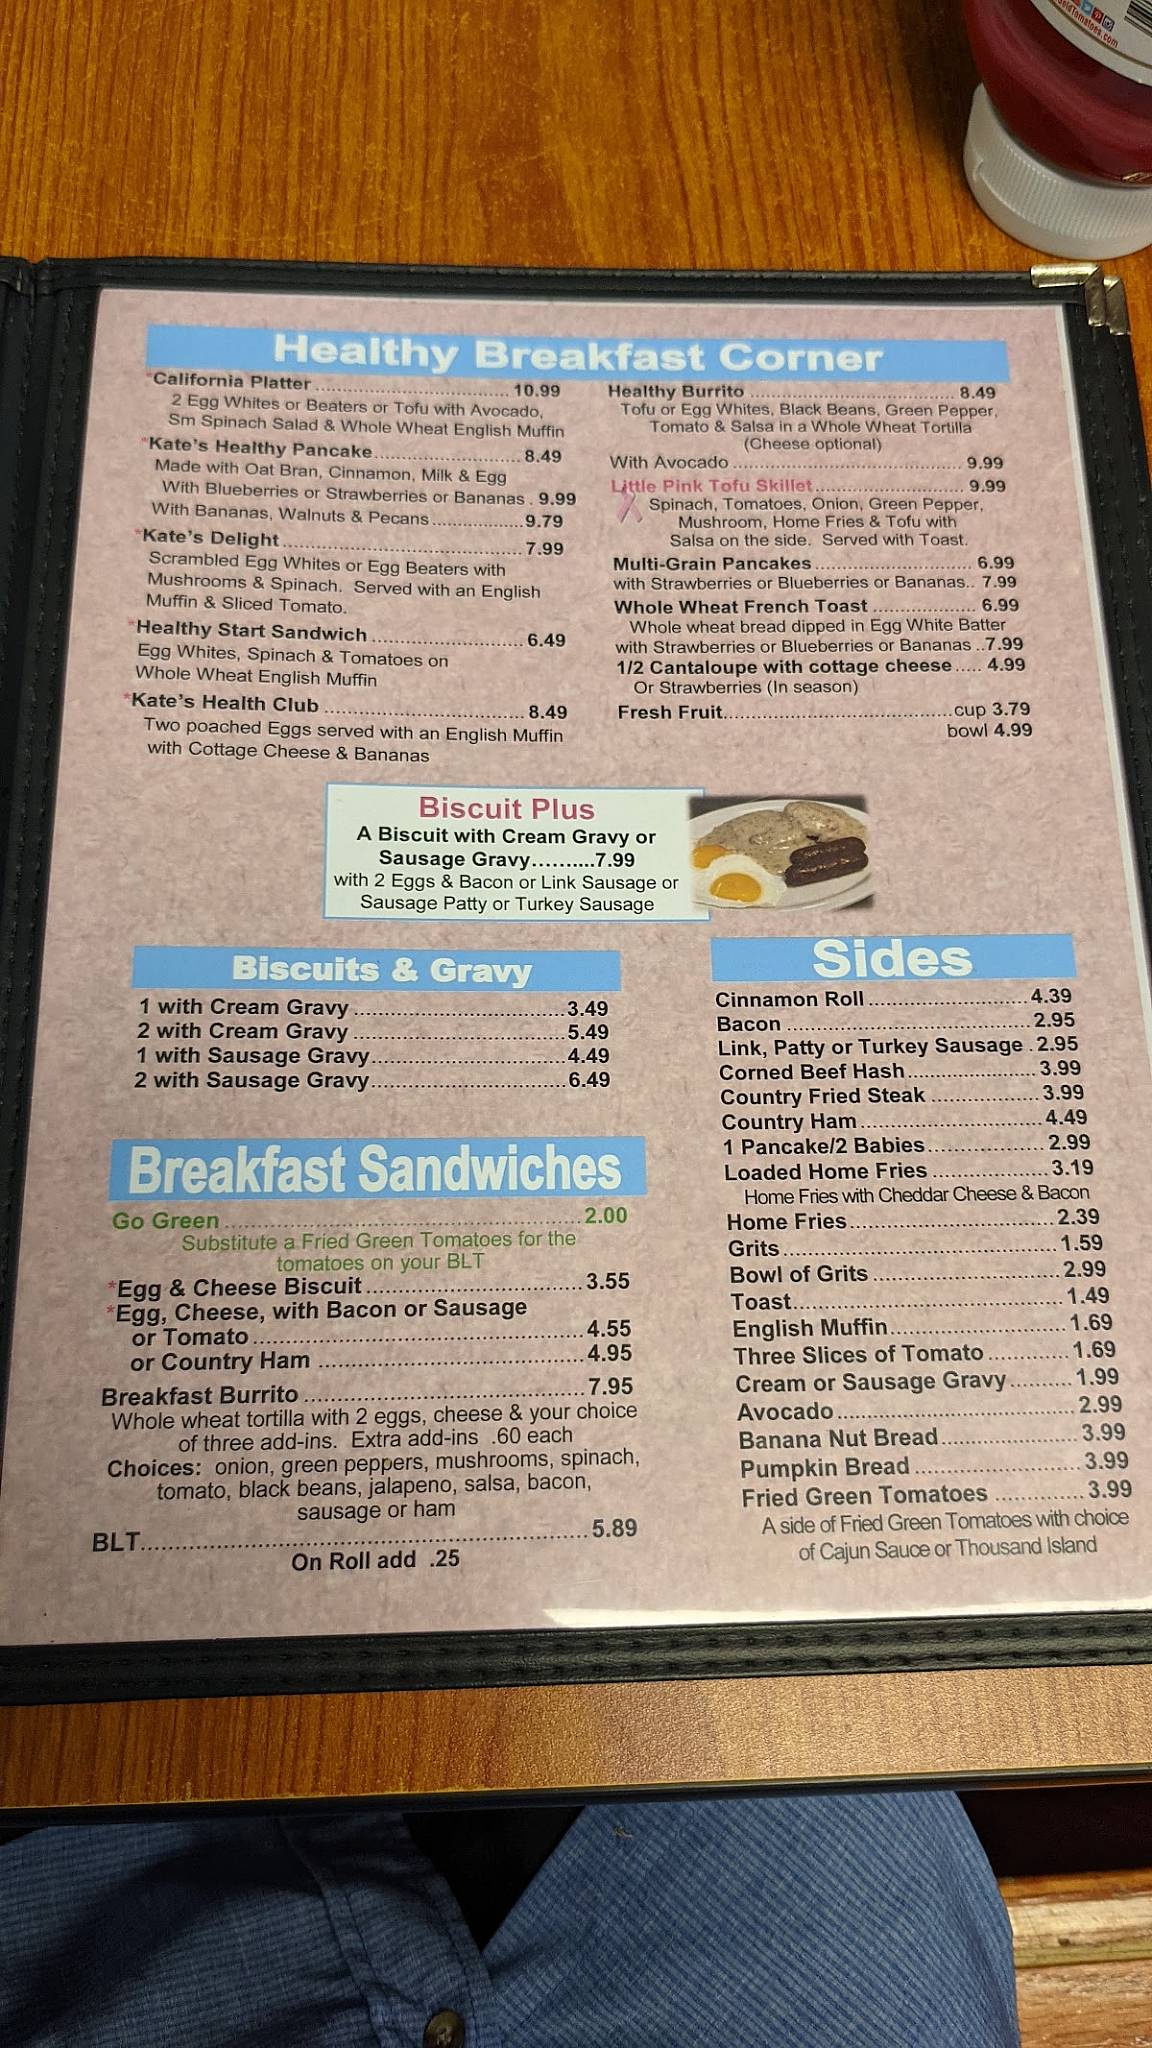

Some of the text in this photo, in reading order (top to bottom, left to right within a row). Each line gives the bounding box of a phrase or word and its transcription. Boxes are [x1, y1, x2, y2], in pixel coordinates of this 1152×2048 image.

[274, 333, 883, 374] Healthy Breakfast Corner
[608, 384, 996, 401] Healthy Burrito 8.49
[171, 393, 543, 420] 2 Egg Whites or Beaters or Tofu with Avocado,
[649, 419, 972, 434] Tomato & Salsa in a Whole Wheat Tortilla
[744, 437, 882, 453] (Cheese optional)
[611, 478, 1006, 493] Little Pink Tofu Skillet 9.99
[678, 514, 957, 530] Mushroom, Home Fries & Tofu with
[613, 556, 1015, 571] Multi-Grain Pancakes 6.99
[146, 593, 347, 614] Muffin & Sliced Tomato.
[614, 598, 1019, 614] Whole Wheat French Toast 6.99
[135, 665, 377, 688] Whole Wheat English Muffin
[617, 657, 1026, 677] 1/2 Cantaloupe with cottage cheese 4.99
[947, 722, 1033, 738] bowl 4.99
[147, 740, 430, 763] with Cottage Cheese & Bananas
[420, 796, 595, 820] Biscuit Plus
[360, 894, 654, 915] Sausage Patty or Turkey Sausage
[813, 938, 973, 978] Sides
[233, 955, 533, 989] Biscuits & Gravy
[140, 998, 608, 1020] 1 with Cream Gravy 3.49
[715, 988, 1072, 1008] Cinnamon Roll 4.39
[717, 1011, 1075, 1032] Bacon 2.95
[719, 1059, 1081, 1081] Corned Beef Hash 3.99
[134, 1071, 610, 1093] 2 with Sausage Gravy 6.49
[722, 1109, 1088, 1133] Country Ham 4.49
[129, 1143, 622, 1194] Breakfast Sandwiches
[724, 1159, 1094, 1181] Loaded Home Fries 3.19
[745, 1184, 1090, 1205] Home Fries with Cheddar Cheese & Bacon
[112, 1206, 628, 1230] Go Green 2.00
[276, 1252, 485, 1273] tomatoes on your BLT
[730, 1260, 1106, 1284] Bowl of Grits 2.99
[130, 1343, 632, 1374] or Country Ham 4.95
[733, 1340, 1116, 1365] Three Slices of Tomato 1.69
[101, 1377, 633, 1407] Breakfast Burrito 7.95
[156, 1473, 591, 1502] tomato, black beans, jalapeno, salsa, bacon,
[742, 1479, 1132, 1508] Fried Green Tomatoes 3.99
[291, 1549, 460, 1572] On Roll add .25
[799, 1535, 1098, 1565] of Cajun Sauce or Thousand Island
